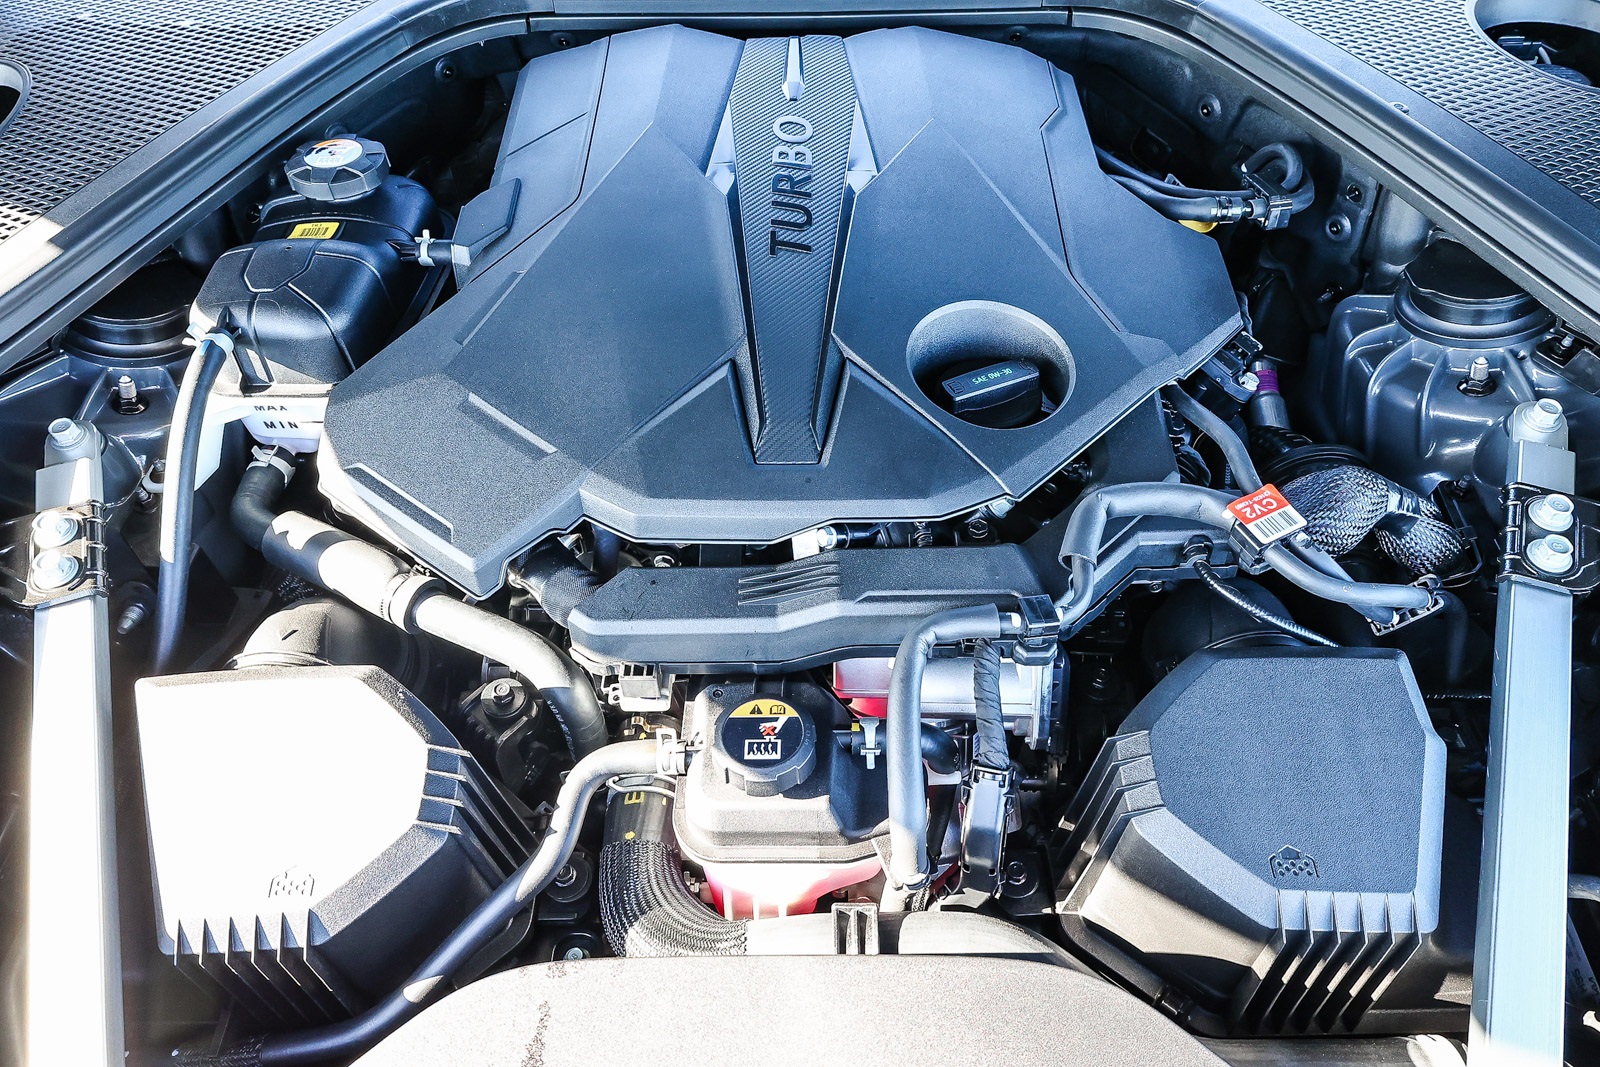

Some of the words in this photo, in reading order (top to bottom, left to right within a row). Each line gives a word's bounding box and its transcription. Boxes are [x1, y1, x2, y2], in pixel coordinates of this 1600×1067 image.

[769, 115, 813, 258] TURBO
[972, 375, 989, 385] SAE
[988, 368, 1013, 380] 0W-30
[263, 421, 299, 430] MIN
[1241, 498, 1278, 519] CV2
